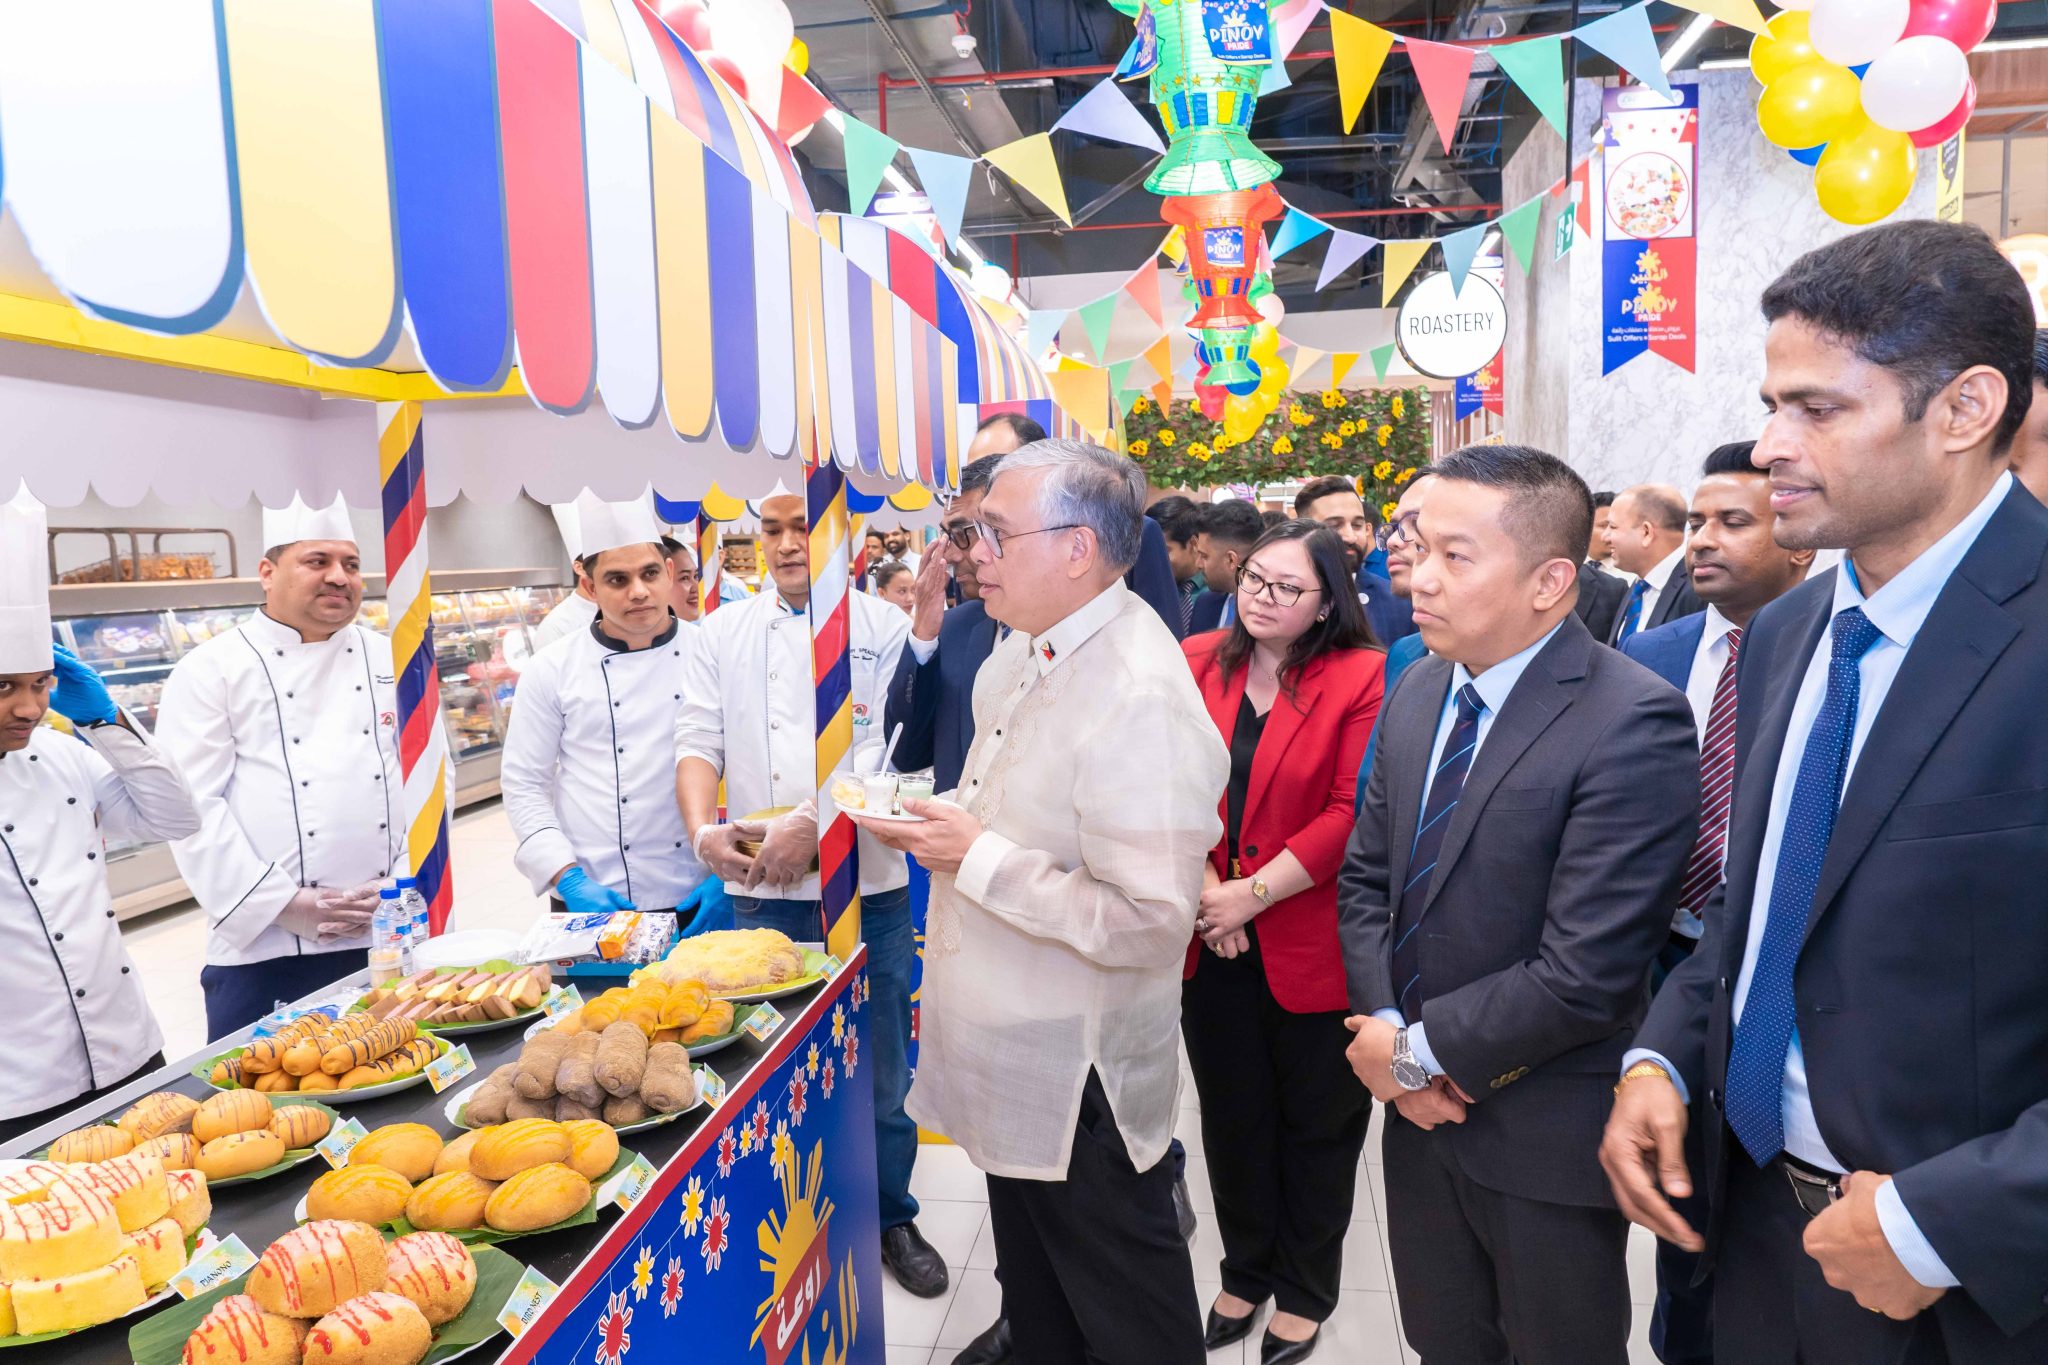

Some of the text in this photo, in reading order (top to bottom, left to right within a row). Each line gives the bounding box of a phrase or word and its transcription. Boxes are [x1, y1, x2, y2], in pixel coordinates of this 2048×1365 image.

[1209, 25, 1264, 43] PINOY
[1207, 243, 1241, 254] PINOY
[1621, 298, 1678, 314] PINOY
[1409, 312, 1494, 336] ROASTERY
[1623, 334, 1643, 342] Offers
[1668, 333, 1687, 341] Deals
[628, 1169, 649, 1202] YEMA BREAD
[200, 1260, 232, 1287] PIANONO
[530, 1290, 543, 1308] NEST
